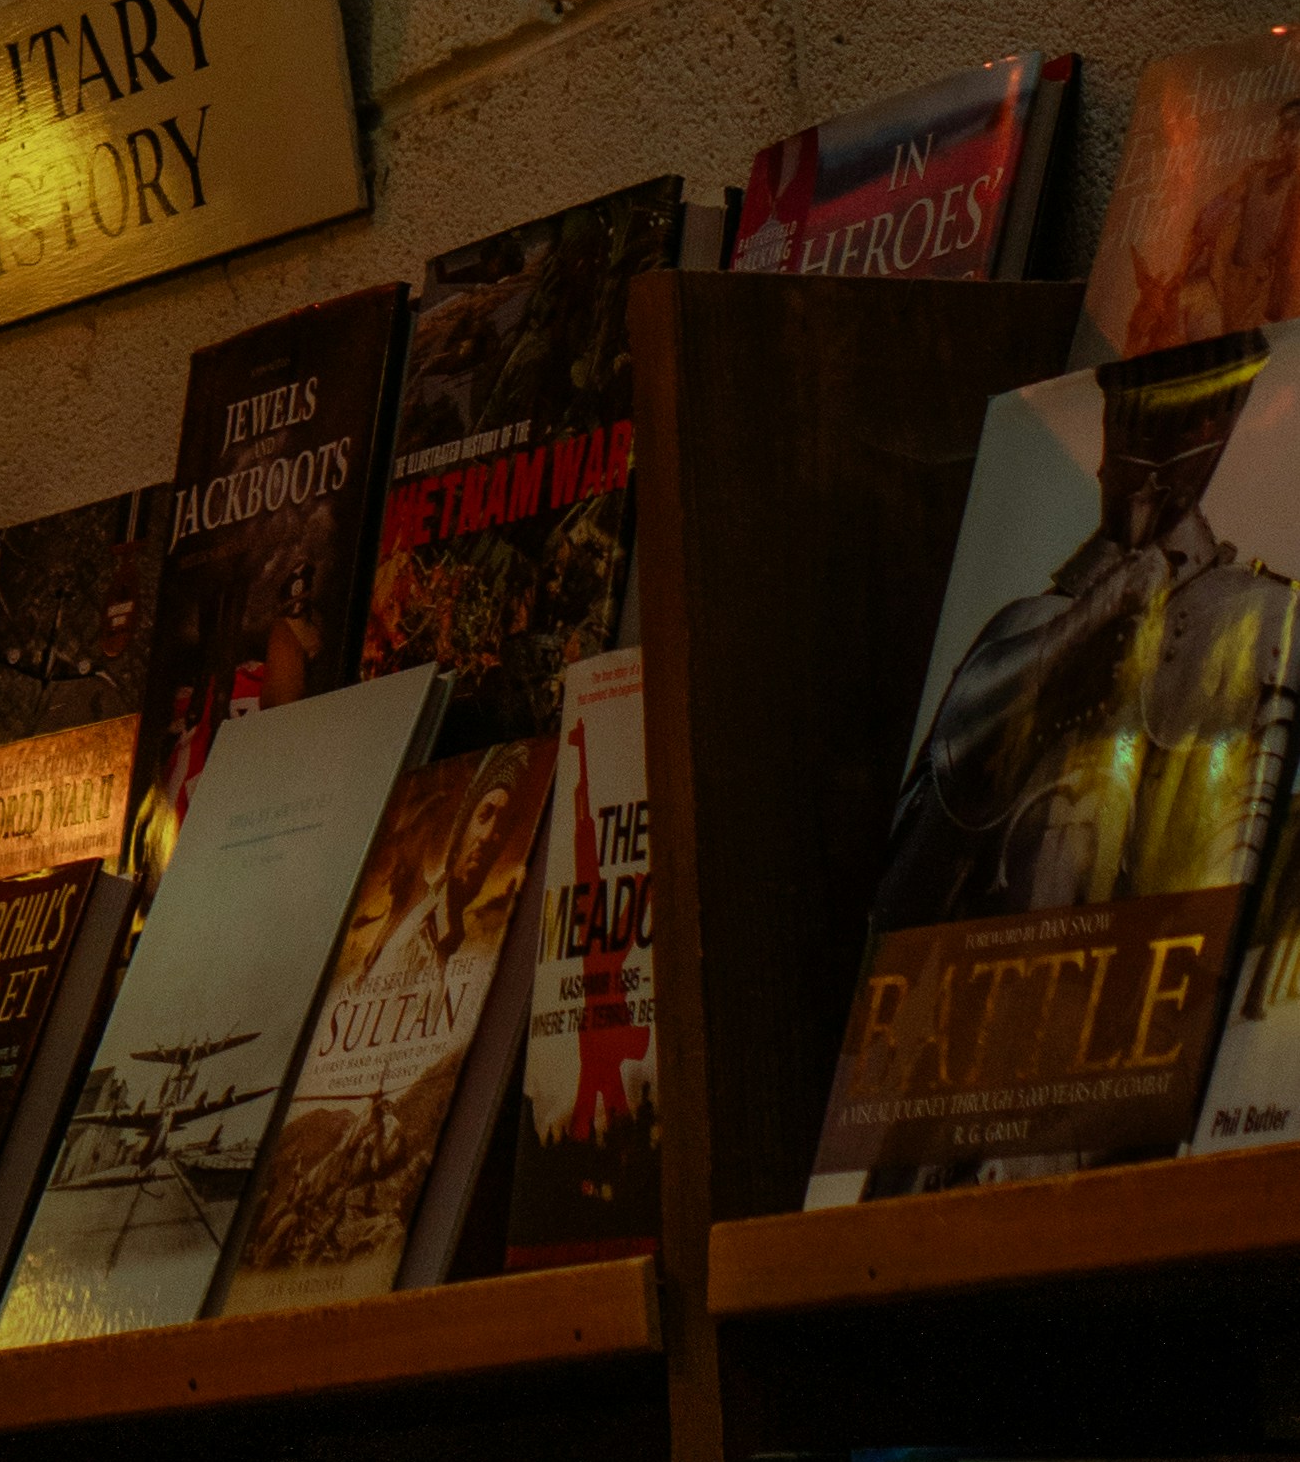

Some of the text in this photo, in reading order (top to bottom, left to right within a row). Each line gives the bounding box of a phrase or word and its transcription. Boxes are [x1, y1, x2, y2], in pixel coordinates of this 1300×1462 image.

[888, 132, 934, 193] IN
[223, 376, 318, 450] JEWELS
[169, 435, 351, 554] JACKBOOTS
[546, 418, 633, 514] WAR
[49, 779, 91, 834] WAR
[598, 800, 649, 866] THE
[317, 981, 472, 1059] SULTAN
[846, 932, 1206, 1100] BATTLE
[984, 1121, 1031, 1143] GRANT
[1210, 1106, 1241, 1138] Phil
